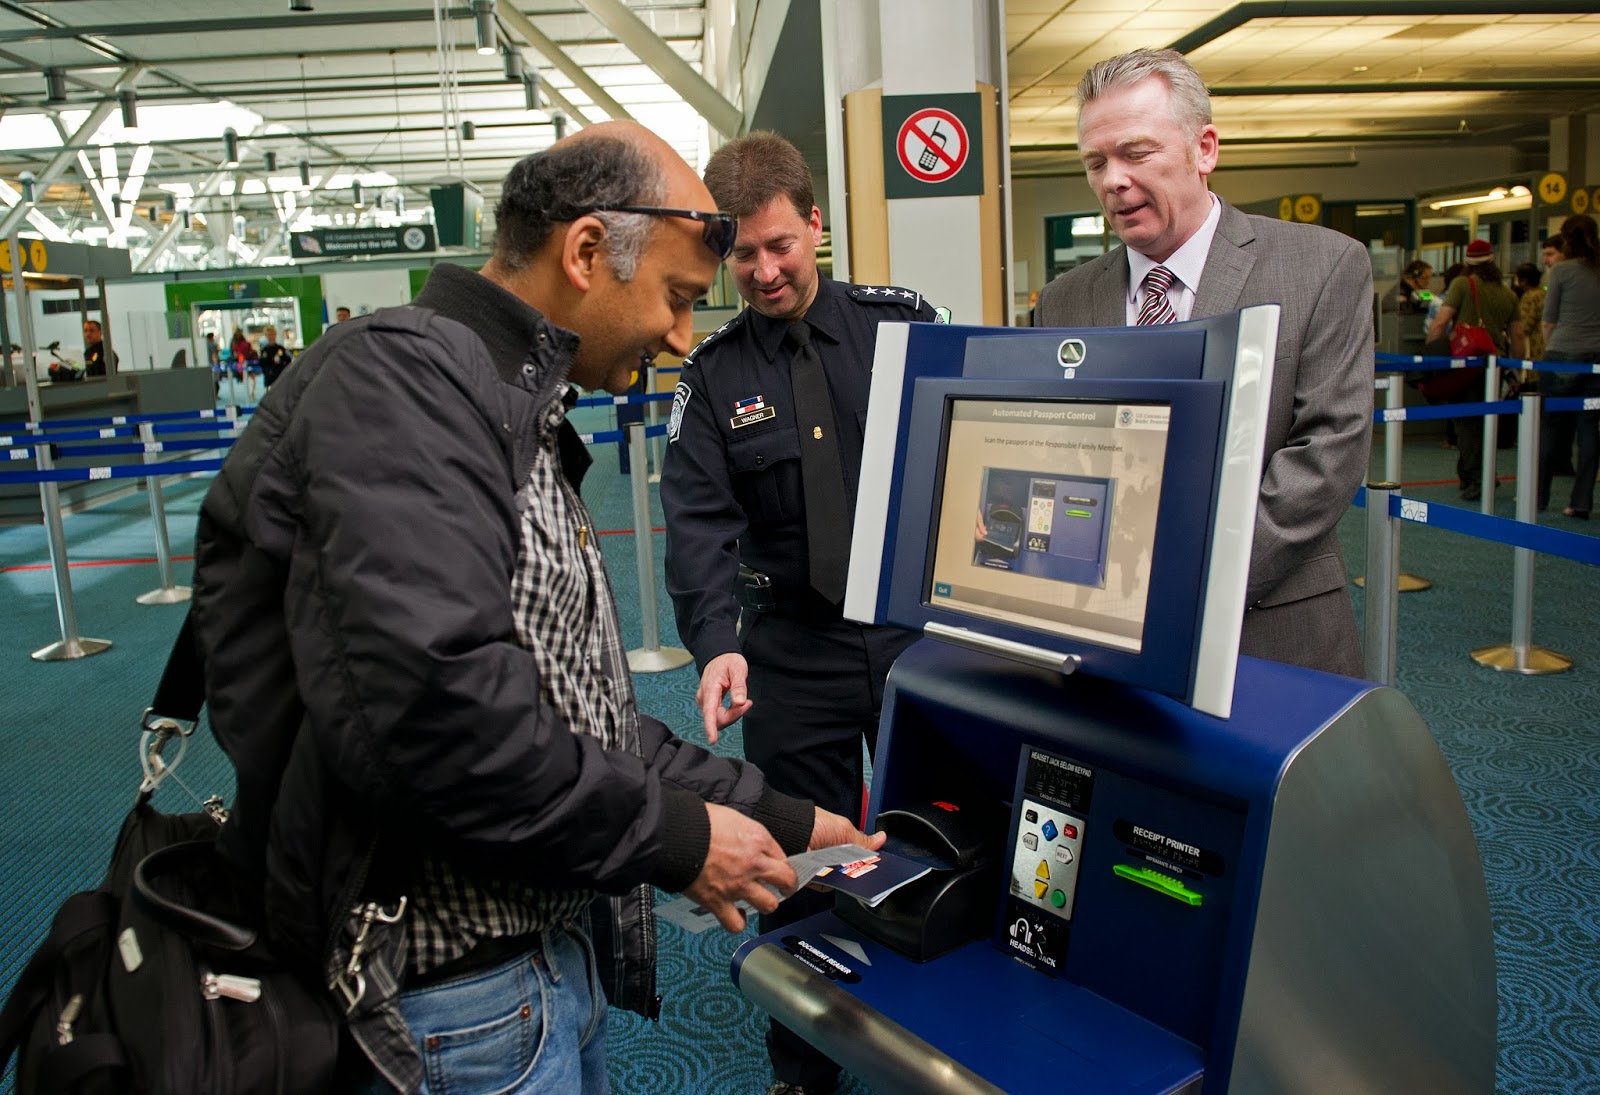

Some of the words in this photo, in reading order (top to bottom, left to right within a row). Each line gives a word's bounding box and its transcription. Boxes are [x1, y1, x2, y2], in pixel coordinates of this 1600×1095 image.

[1546, 182, 1559, 194] 14
[325, 242, 358, 251] Welcome
[359, 242, 368, 250] to
[368, 240, 380, 249] the
[381, 239, 398, 248] USA
[36, 249, 41, 262] 7
[741, 412, 764, 423] WAGNER
[992, 409, 1032, 418] Automated
[1033, 410, 1065, 420] Passport
[1066, 411, 1096, 420] Control
[1045, 440, 1077, 449] Responsible
[1078, 443, 1096, 451] Family
[1401, 505, 1426, 521] YVR
[938, 586, 948, 594] Quit
[1031, 751, 1050, 764] HEADSET
[1048, 757, 1060, 767] JACK
[1060, 760, 1075, 772] BELOW
[1074, 766, 1092, 778] KEYPAD
[1023, 837, 1033, 846] BACK
[1133, 826, 1165, 844] RECEIPT
[1166, 838, 1200, 857] PRINTER
[1057, 851, 1068, 860] NEXT
[798, 940, 830, 960] DOCUMENT
[826, 958, 852, 975] READER
[1038, 954, 1057, 968] JACK
